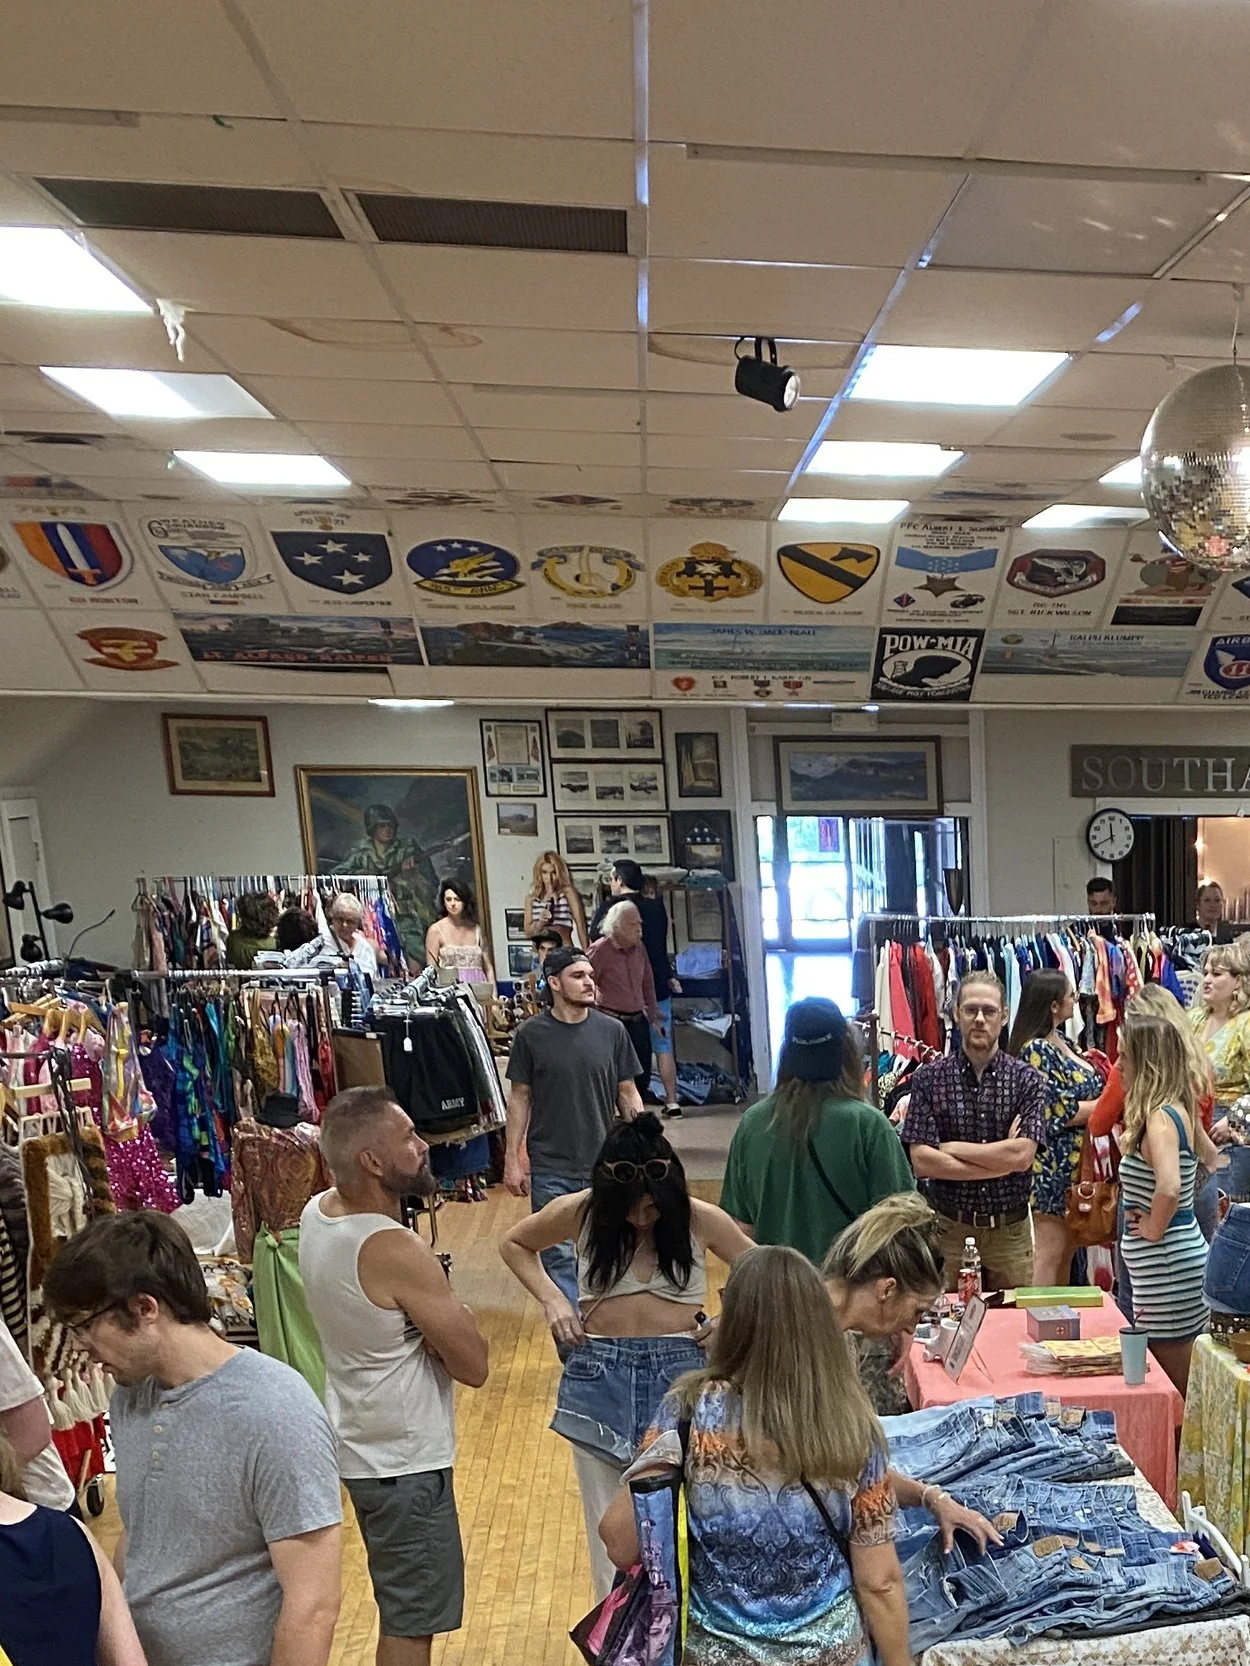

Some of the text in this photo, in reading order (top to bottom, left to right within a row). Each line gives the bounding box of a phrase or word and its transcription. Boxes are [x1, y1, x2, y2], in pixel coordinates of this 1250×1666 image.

[881, 634, 979, 660] POW MIA
[440, 1096, 465, 1111] ARMY
